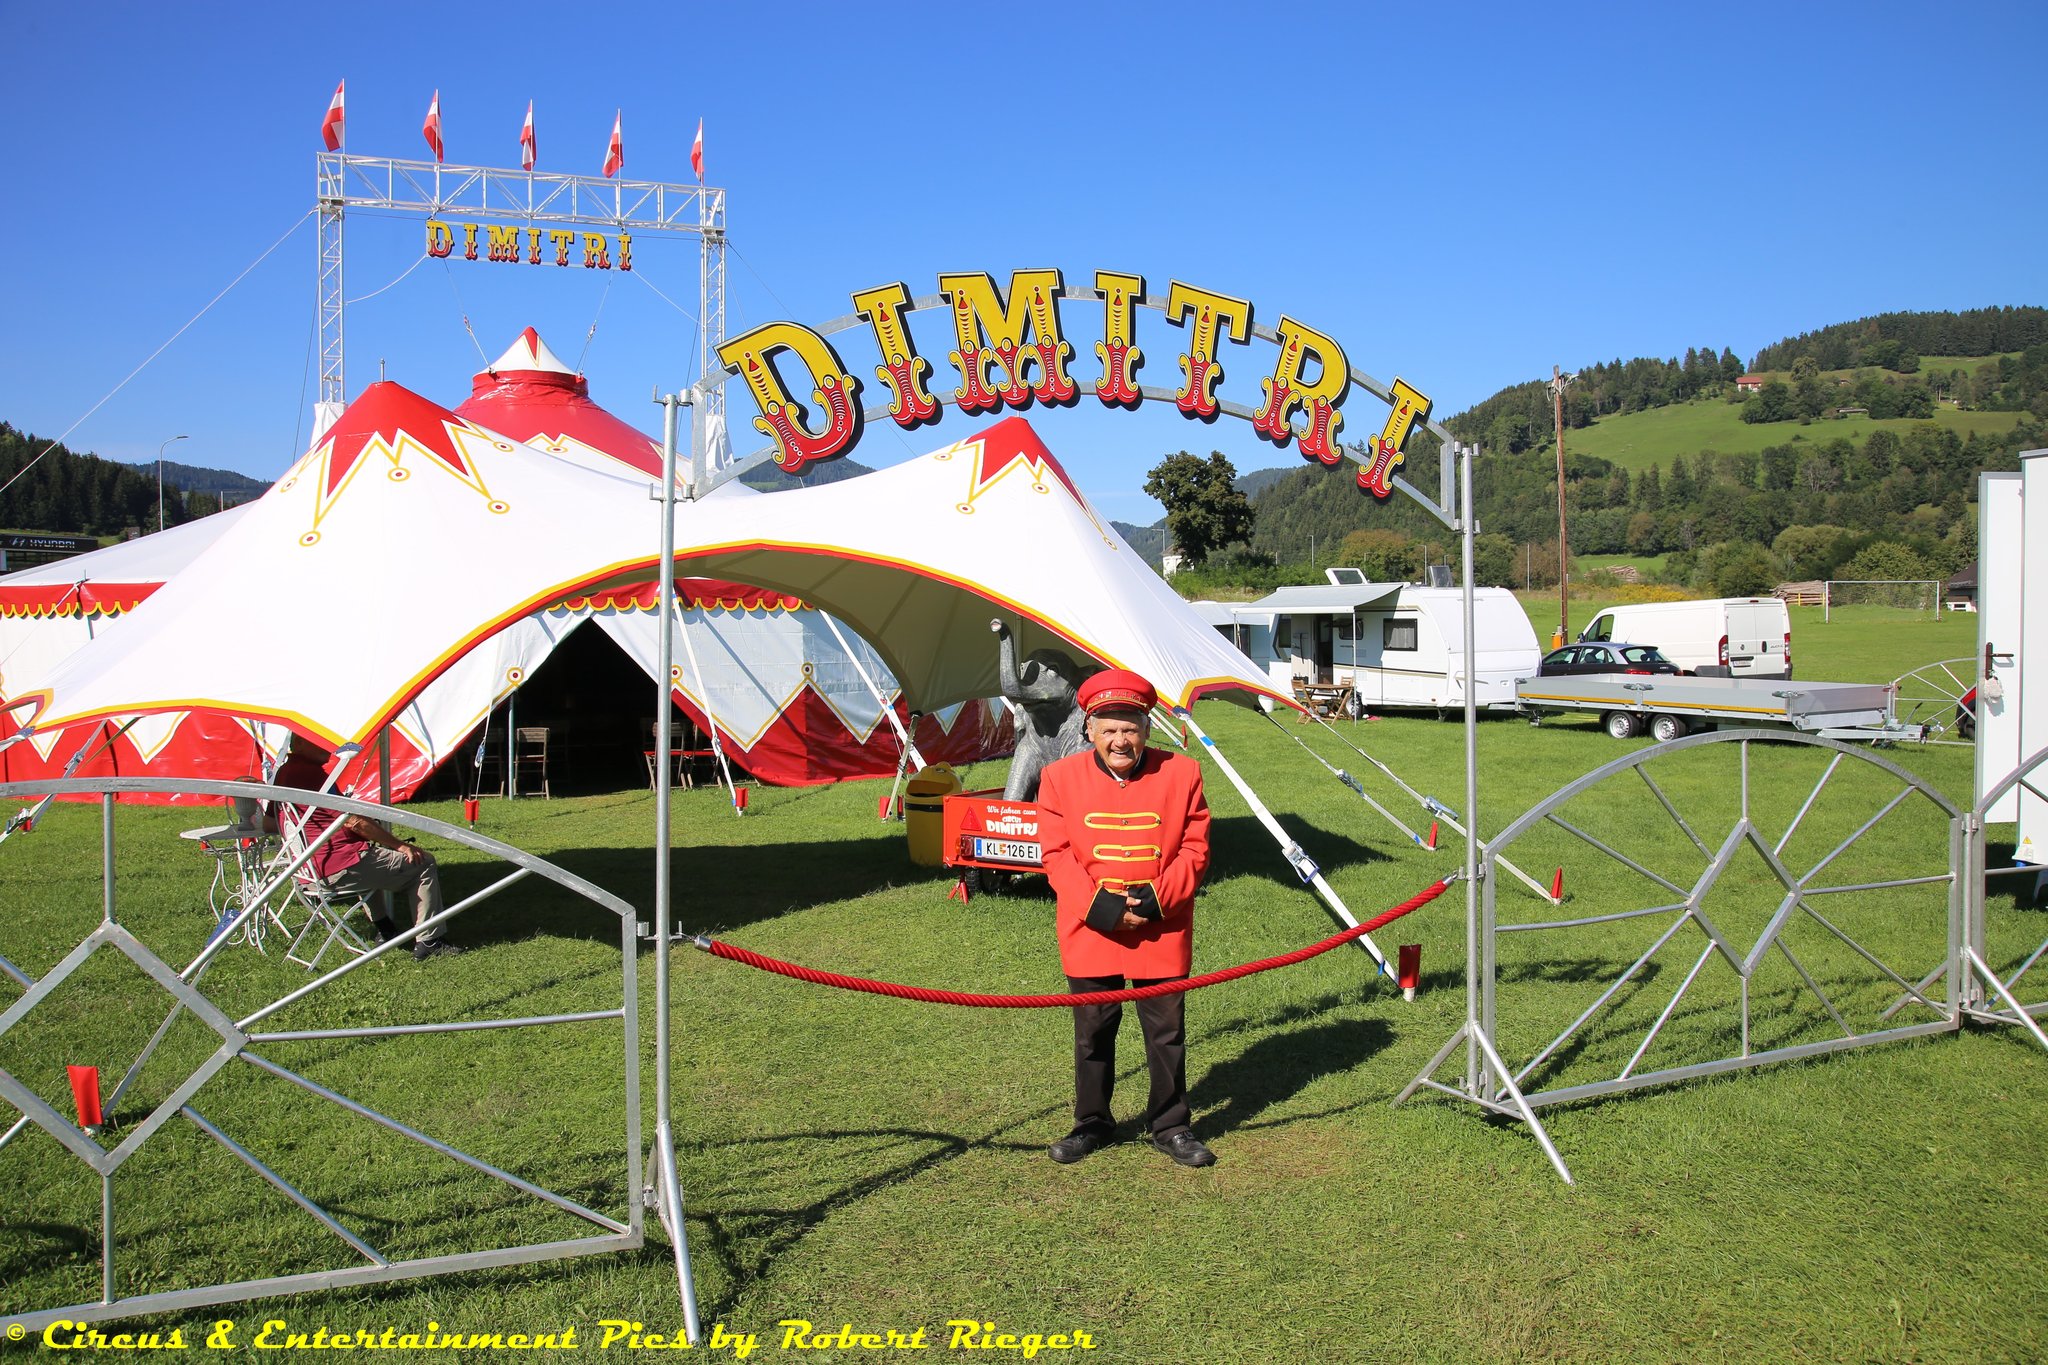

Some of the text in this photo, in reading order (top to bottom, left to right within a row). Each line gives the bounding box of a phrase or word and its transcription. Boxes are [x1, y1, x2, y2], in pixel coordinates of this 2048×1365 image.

[426, 220, 632, 271] DIMITRI
[716, 267, 1433, 499] DIMITRI
[30, 539, 75, 549] HYUNDAI
[987, 805, 999, 813] Wir
[1000, 805, 1021, 816] fahren
[985, 820, 1038, 836] DIMITRI
[987, 842, 998, 856] KL
[1007, 844, 1025, 858] 126
